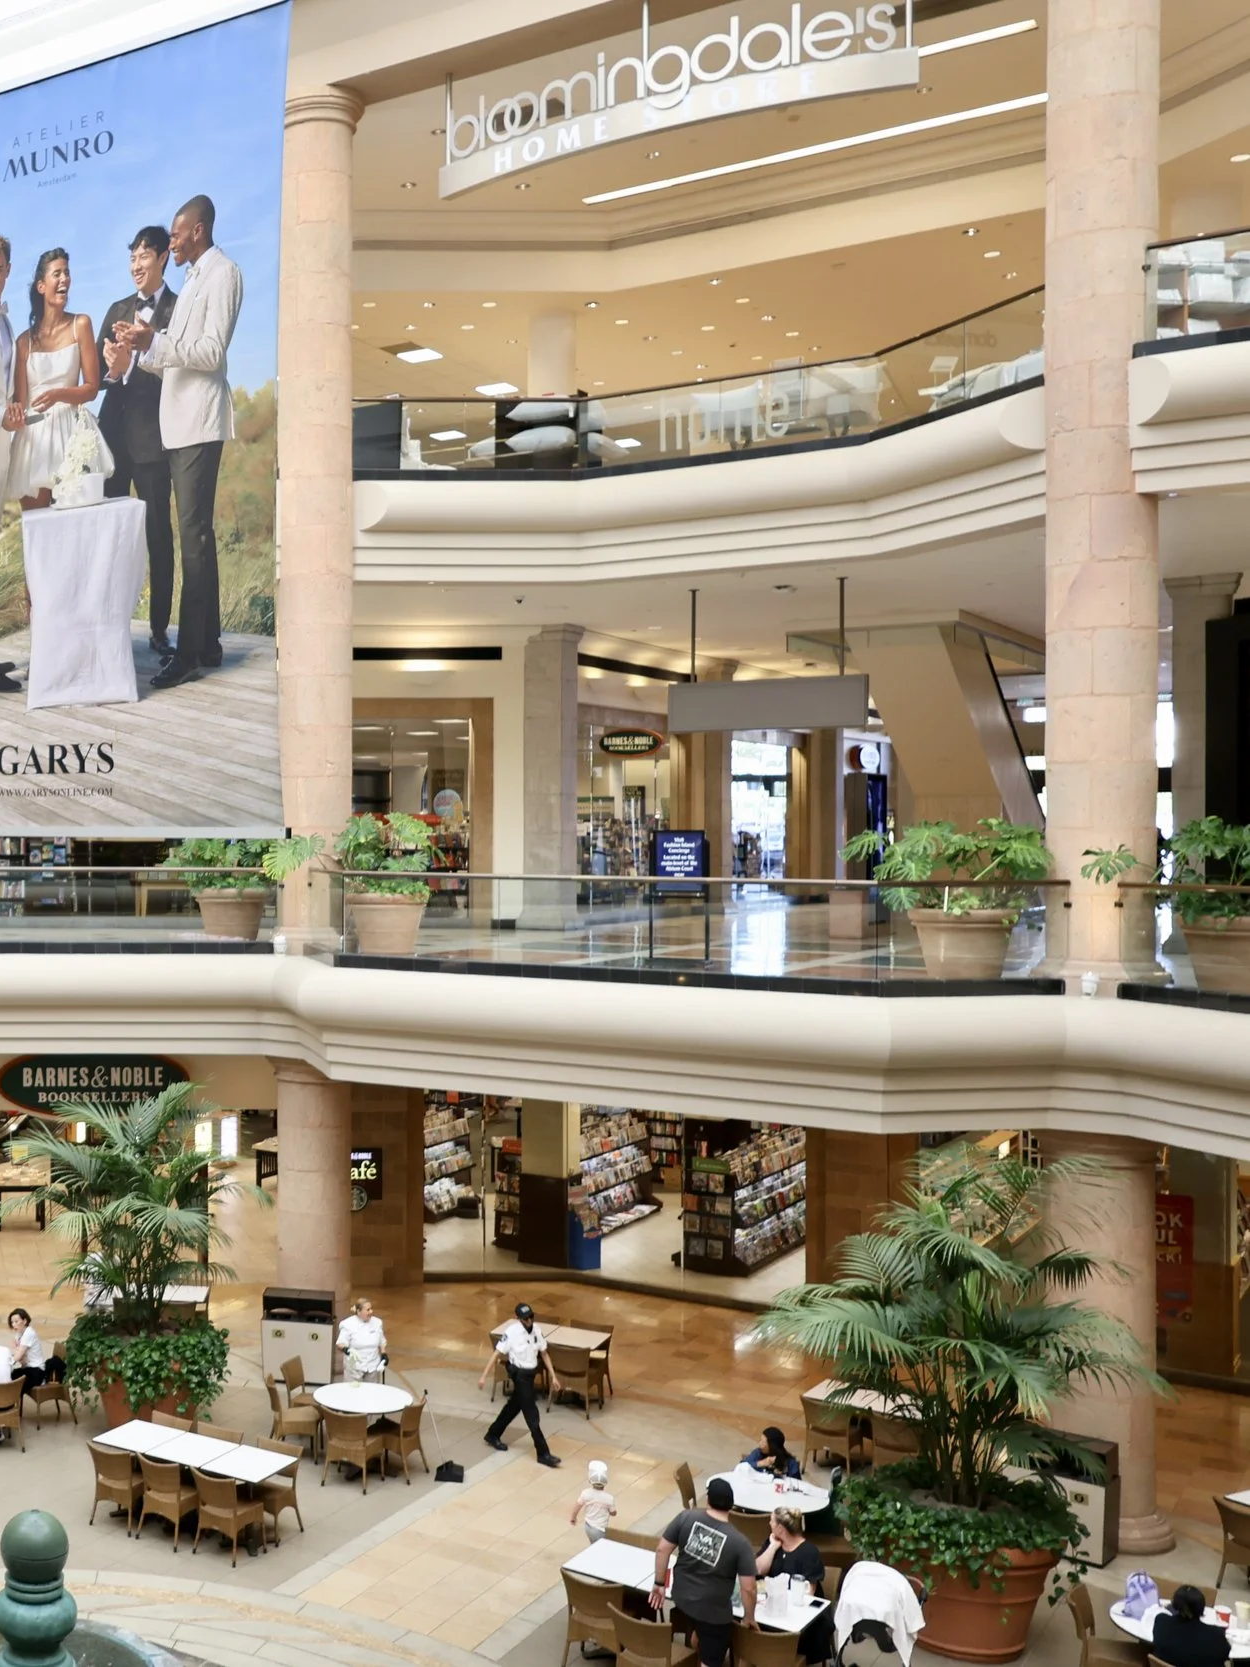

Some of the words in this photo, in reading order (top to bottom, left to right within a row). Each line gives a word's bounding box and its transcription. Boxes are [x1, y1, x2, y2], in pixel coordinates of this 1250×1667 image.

[449, 3, 897, 158] bloomingdale's
[12, 110, 104, 149] ATELIER
[493, 115, 609, 174] HOME
[2, 130, 114, 182] MUNRO
[37, 1091, 150, 1103] BOOKSELLERS
[350, 1160, 377, 1180] afé
